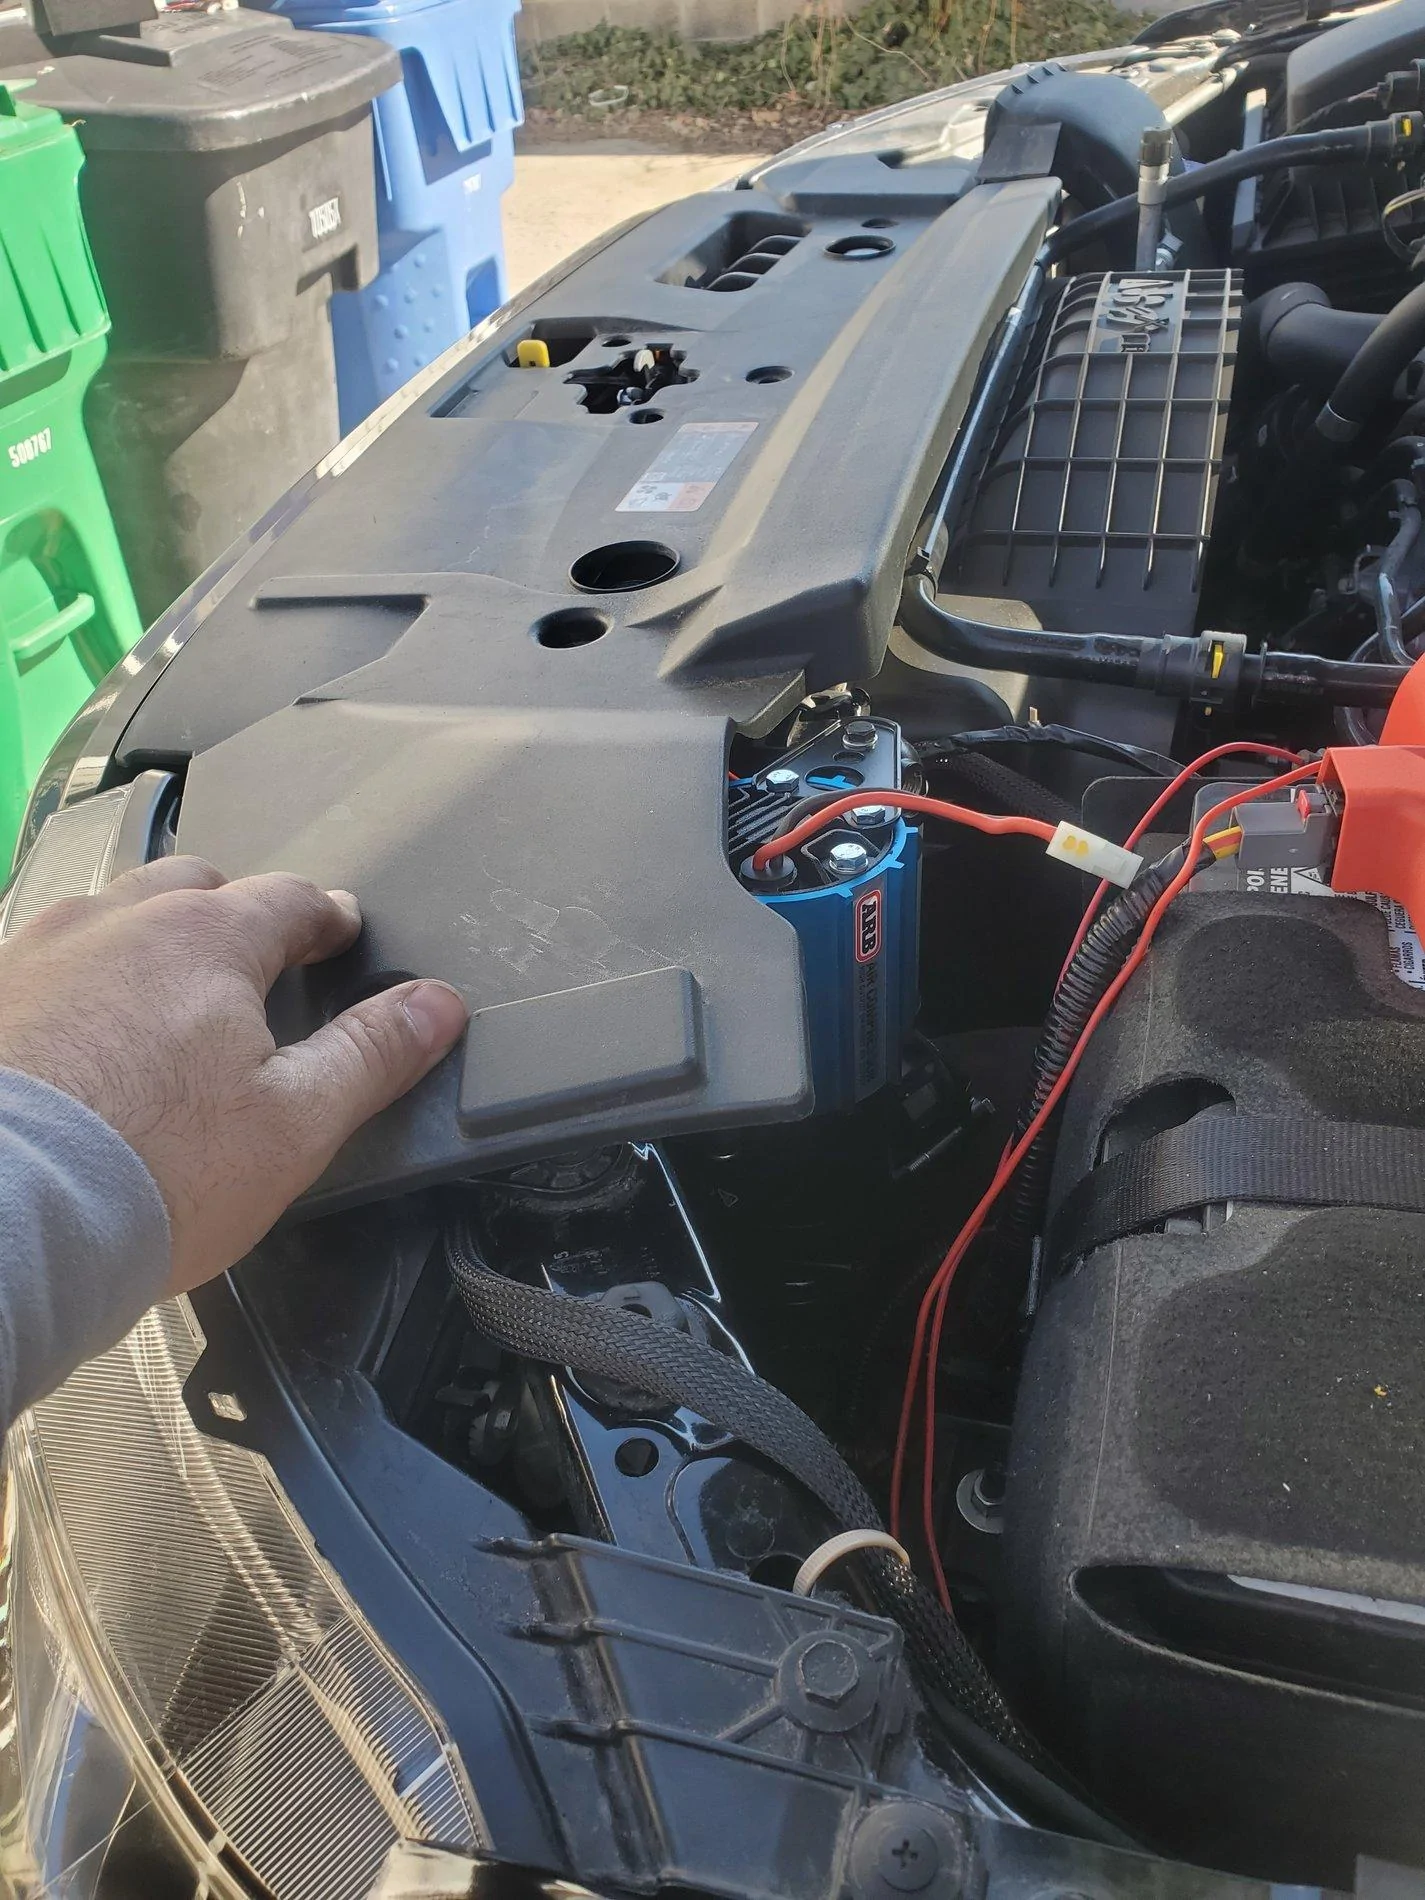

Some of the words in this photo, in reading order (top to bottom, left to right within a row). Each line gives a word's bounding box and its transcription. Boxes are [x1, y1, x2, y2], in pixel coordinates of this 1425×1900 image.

[8, 427, 52, 468] 500767
[861, 901, 877, 955] ARB
[1402, 941, 1415, 970] CIGARROS
